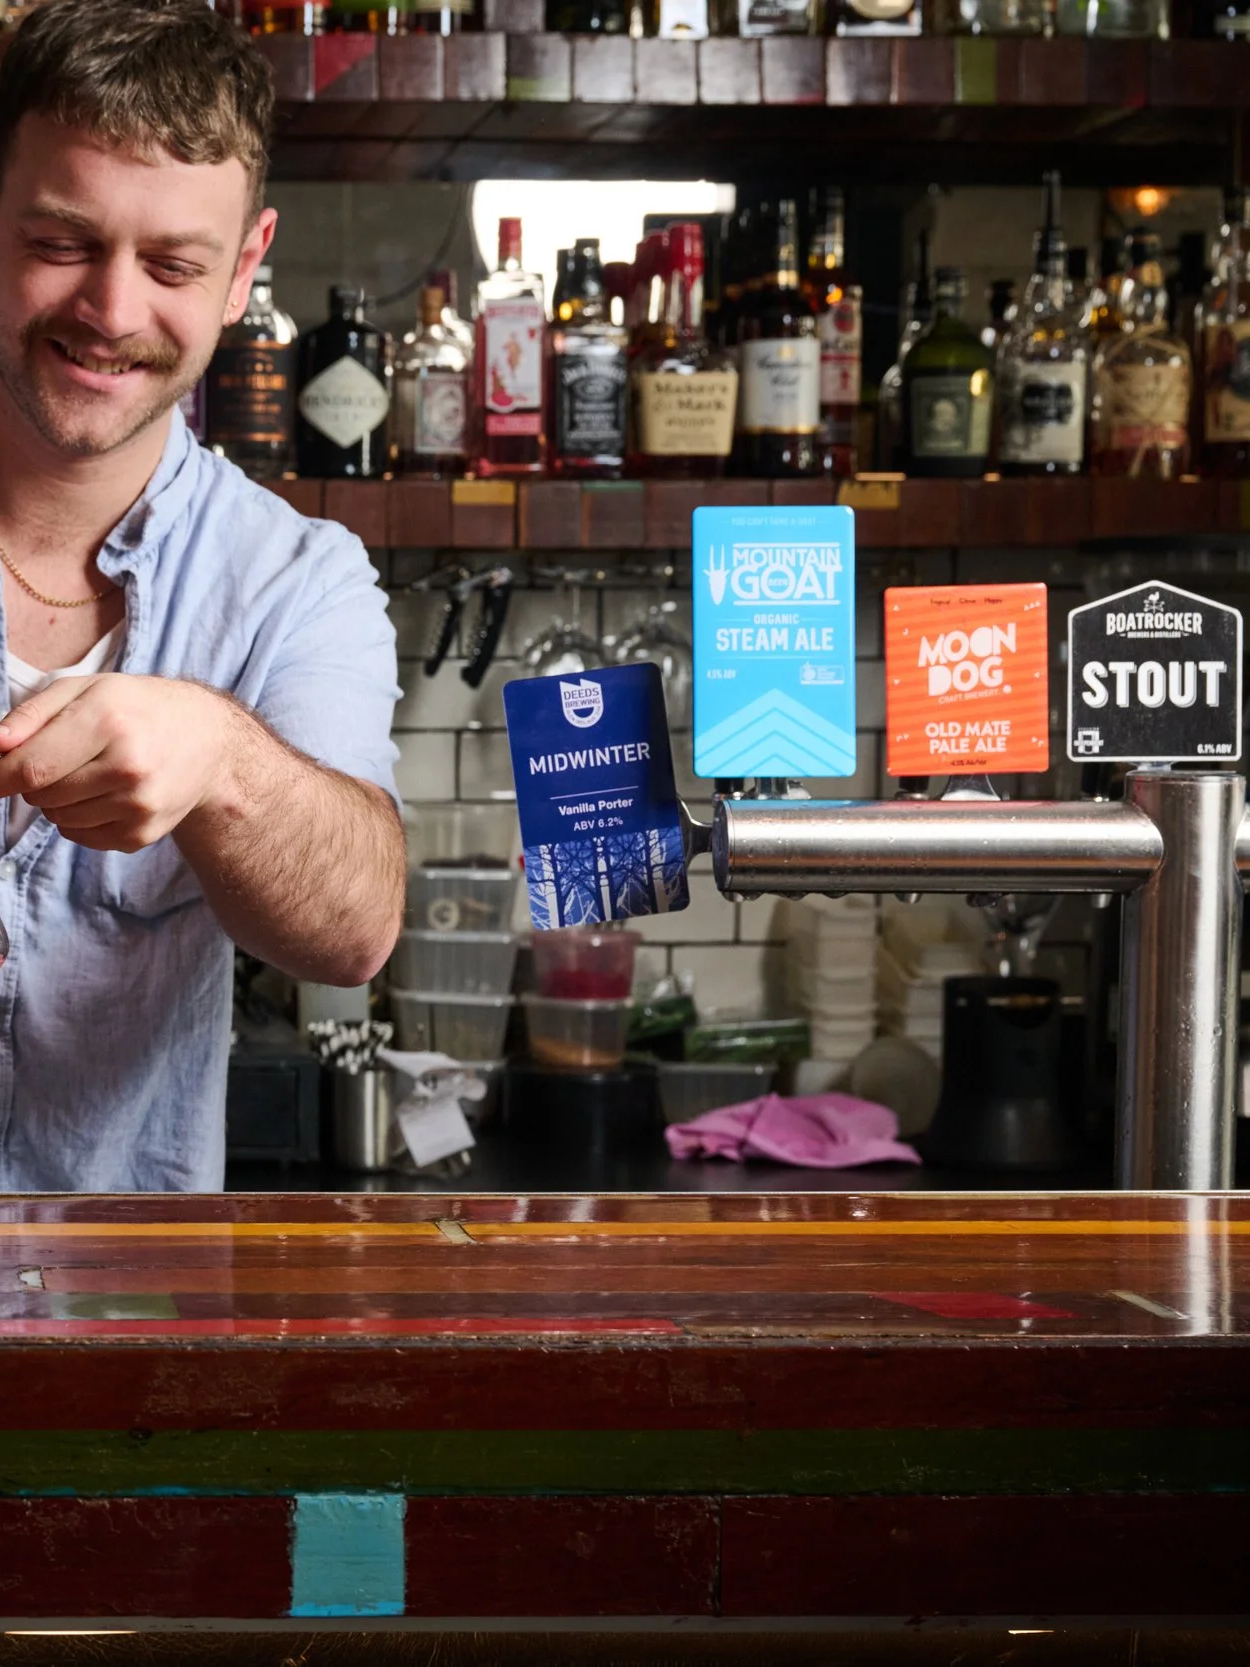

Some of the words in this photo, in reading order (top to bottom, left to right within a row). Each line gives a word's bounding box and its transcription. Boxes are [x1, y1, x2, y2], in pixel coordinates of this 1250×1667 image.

[732, 548, 842, 570] MOUNTAIN
[730, 564, 843, 600] GOAT
[753, 613, 800, 625] ORGANIC
[1106, 612, 1203, 636] BOATROCKER
[716, 627, 789, 652] STEAM
[794, 627, 835, 651] ALE
[917, 622, 1016, 668] MOON
[928, 655, 1003, 697] DOG
[1081, 660, 1228, 709] STOUT
[563, 687, 600, 701] DEEDS
[565, 697, 601, 709] BREWING
[937, 692, 963, 705] CRAFT
[964, 688, 999, 700] BREWERY
[925, 721, 961, 738] OLD
[965, 720, 1011, 737] MATE
[929, 738, 971, 755] PALE
[974, 737, 1007, 753] ALE
[1215, 743, 1232, 754] ABV
[529, 742, 651, 776] MIDWINTER
[558, 802, 596, 816] Vanilla
[597, 797, 634, 811] Porter
[573, 819, 595, 832] ABV
[597, 816, 624, 829] 6.2%
